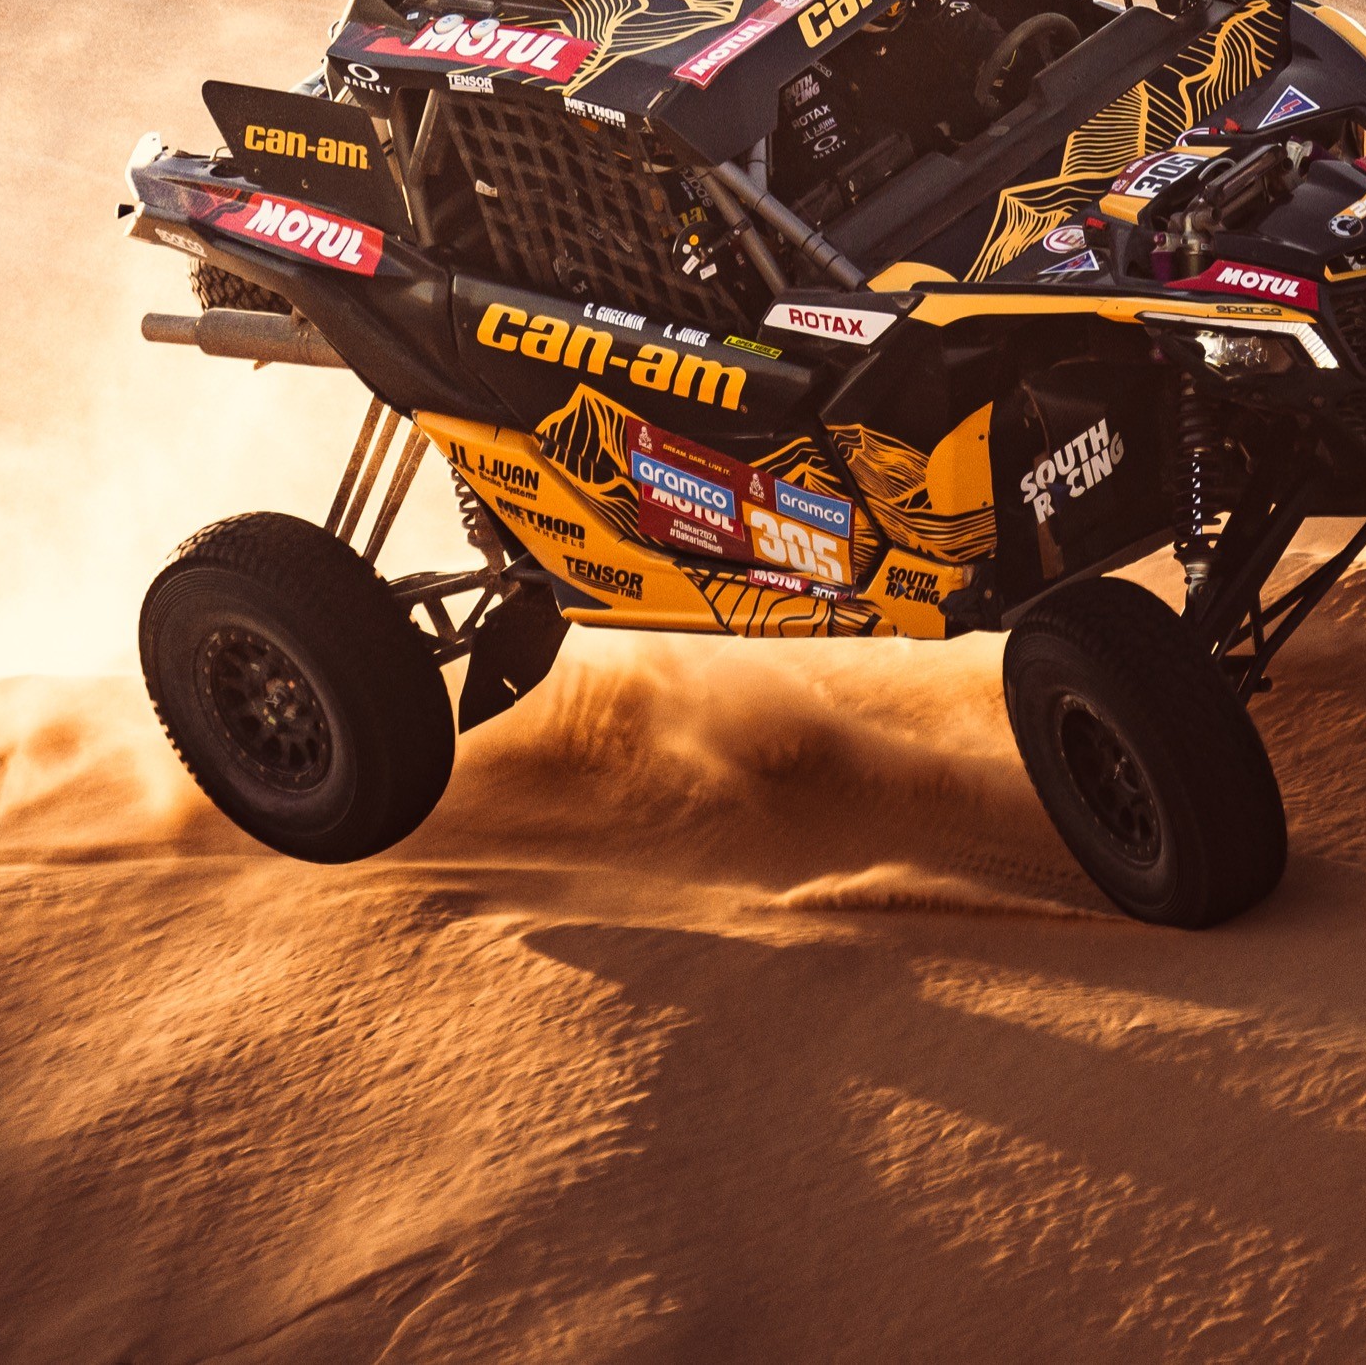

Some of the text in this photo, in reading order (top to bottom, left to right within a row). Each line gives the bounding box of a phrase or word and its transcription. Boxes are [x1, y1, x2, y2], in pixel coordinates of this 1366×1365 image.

[408, 22, 569, 71] MOTUL
[688, 22, 767, 77] MOTUL
[342, 75, 391, 95] OAKLEY
[447, 73, 494, 88] TENSOR
[563, 96, 626, 123] METHOD
[244, 124, 369, 170] can-am
[1132, 153, 1199, 194] 305
[244, 199, 364, 265] MOTUL
[1216, 267, 1300, 298] MOTUL
[583, 303, 647, 331] G. GUGELMIN
[788, 307, 865, 338] ROTAX
[1216, 305, 1283, 316] sparco
[663, 323, 710, 347] A. JONES
[476, 302, 747, 411] can-am
[478, 454, 540, 492] J.JUAN
[663, 443, 687, 458] DREAM.
[688, 454, 708, 467] DARE.
[708, 461, 722, 473] LIVE
[1020, 417, 1110, 504] SOUTH
[503, 483, 538, 501] Systems
[639, 461, 728, 509] aramco
[495, 495, 585, 541] METHOD
[780, 492, 845, 525] aramco
[533, 525, 586, 550] WHEELS
[673, 518, 718, 543] #Dakar2024
[750, 510, 843, 583] 305
[562, 554, 644, 592] TENSOR
[753, 569, 804, 592] MOTUL
[886, 566, 939, 590] SOUTH
[619, 587, 643, 601] TIRE
